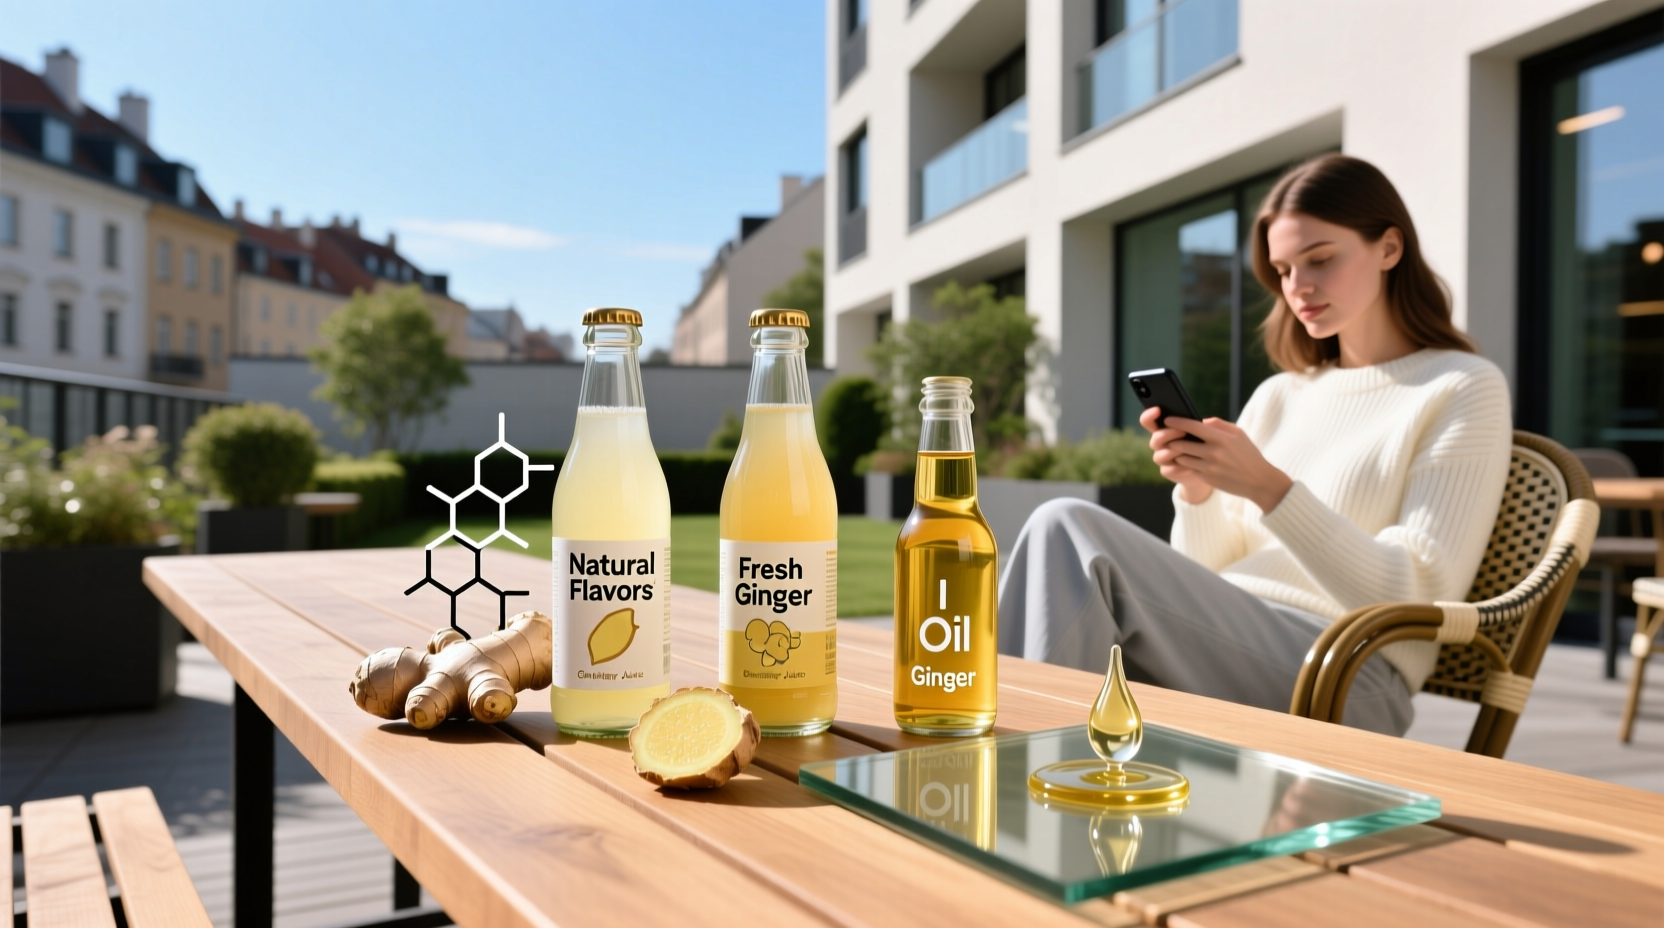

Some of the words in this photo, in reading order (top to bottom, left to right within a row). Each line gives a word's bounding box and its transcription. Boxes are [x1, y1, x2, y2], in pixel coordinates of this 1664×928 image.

[569, 551, 655, 576] Natural
[739, 557, 803, 580] Fresh
[570, 578, 654, 602] Flavors
[735, 582, 813, 614] Ginger
[919, 615, 970, 653] Oil
[911, 665, 977, 693] Ginger
